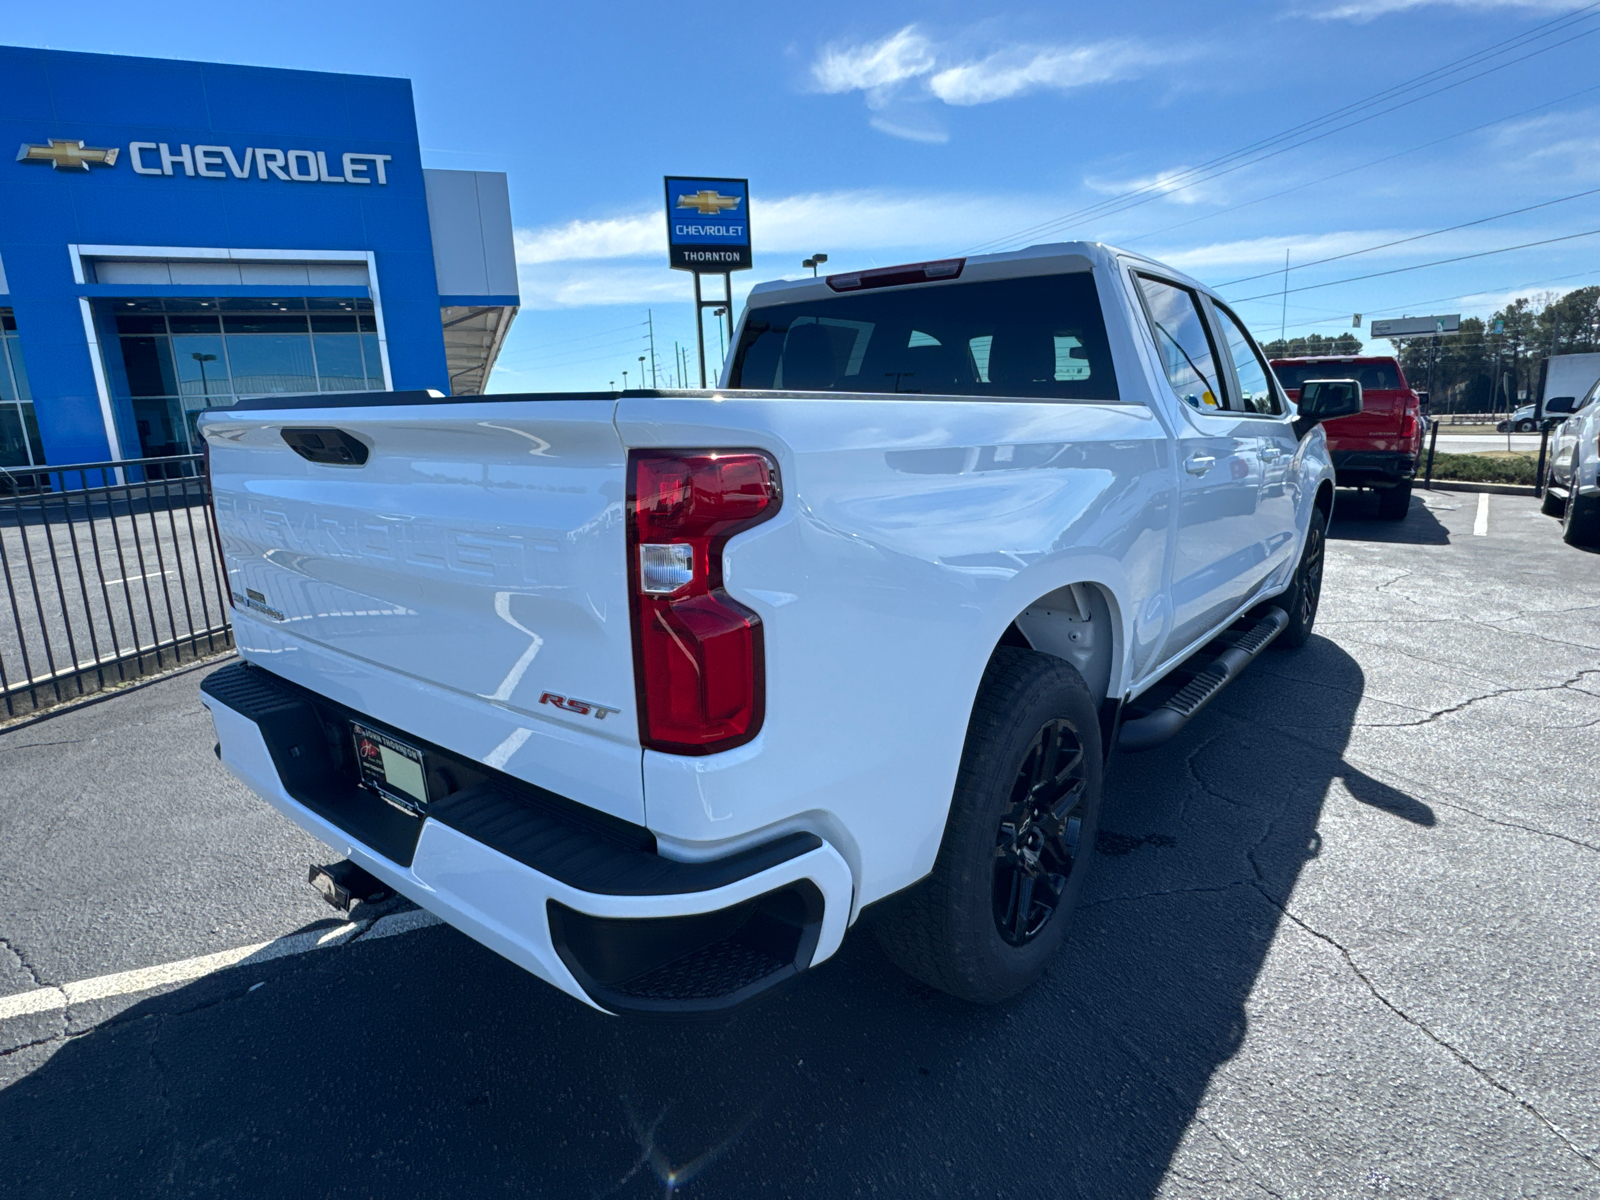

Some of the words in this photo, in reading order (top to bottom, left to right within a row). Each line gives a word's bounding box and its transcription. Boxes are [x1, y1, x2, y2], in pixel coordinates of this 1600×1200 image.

[129, 141, 392, 184] CHEVROLET
[676, 225, 743, 236] CHEVROLET
[684, 252, 740, 261] THORNTON
[539, 691, 620, 720] RST
[382, 738, 418, 760] THORNTON
